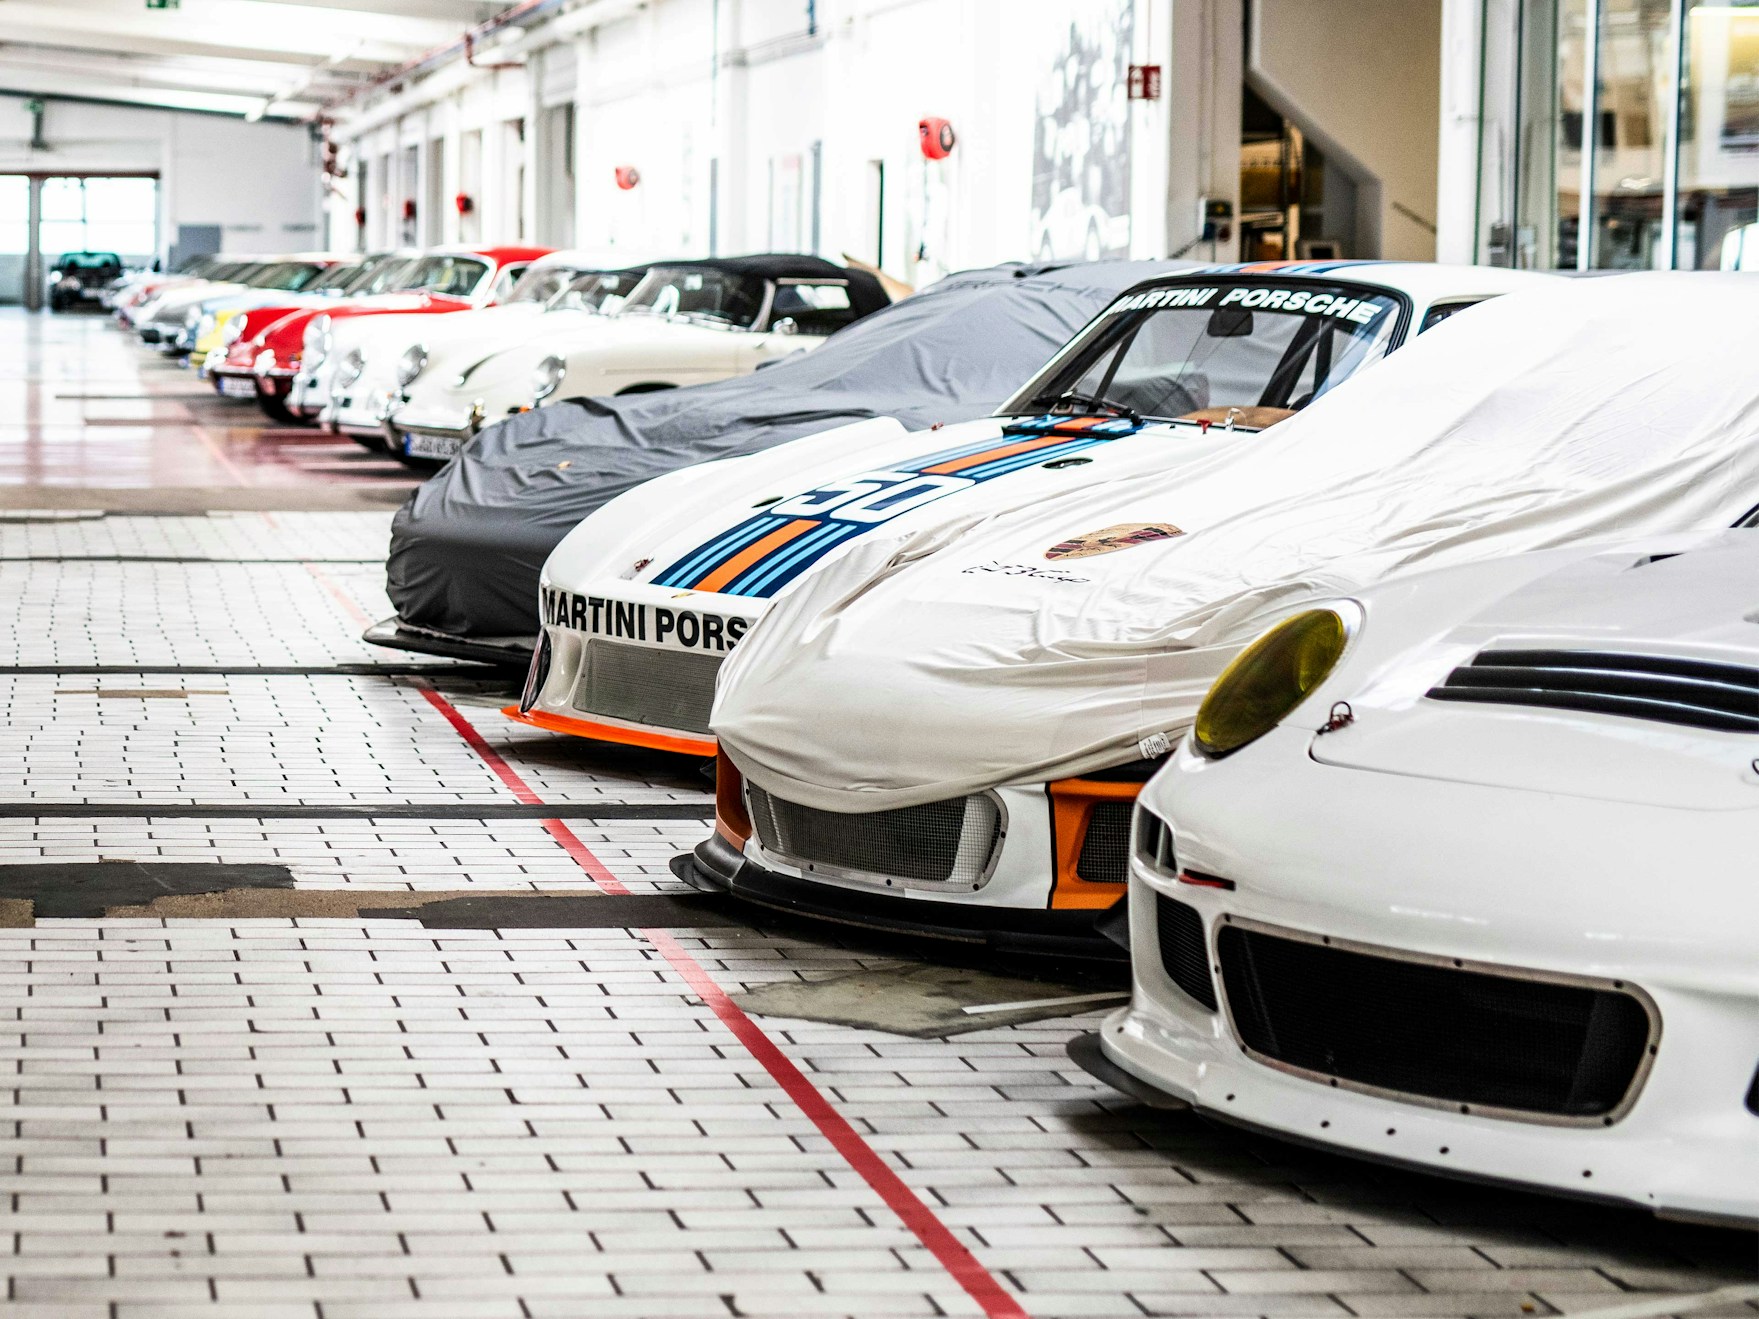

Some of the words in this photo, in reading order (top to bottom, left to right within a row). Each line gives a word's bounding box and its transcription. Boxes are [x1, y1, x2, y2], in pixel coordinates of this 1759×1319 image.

[1106, 287, 1219, 315] MARTINI
[1218, 287, 1383, 325] PORSCHE
[542, 587, 646, 642] MARTINI
